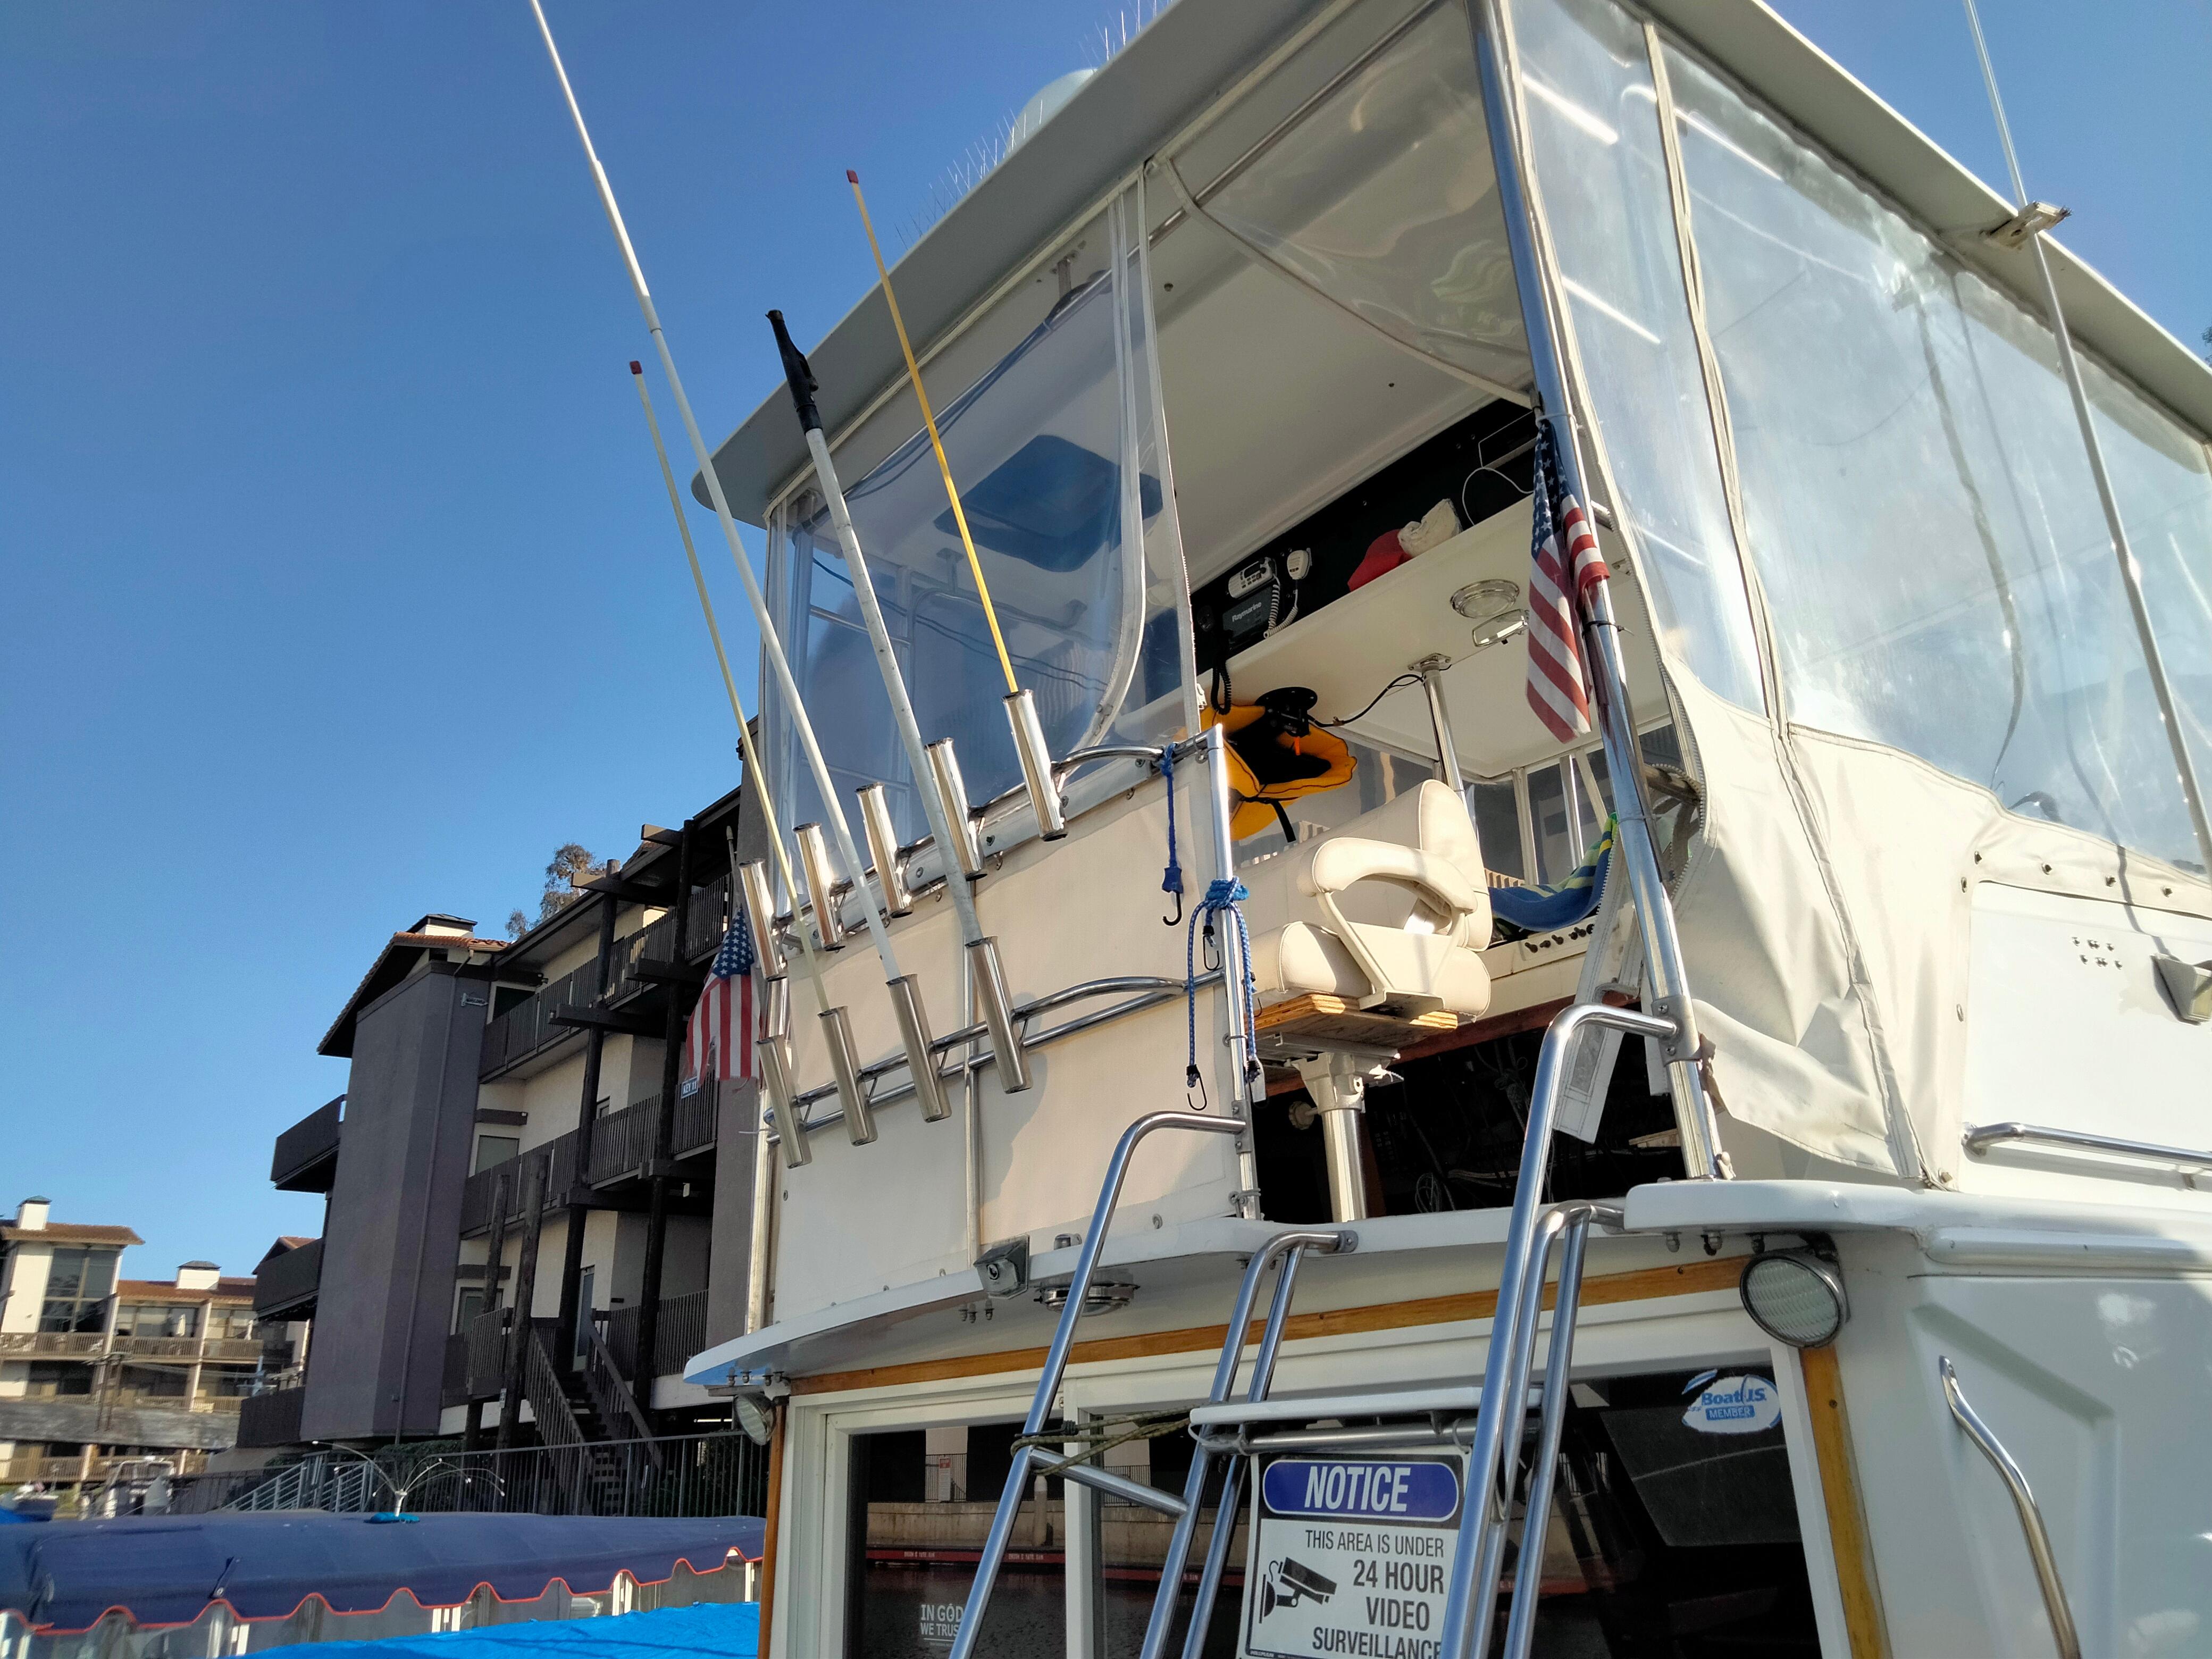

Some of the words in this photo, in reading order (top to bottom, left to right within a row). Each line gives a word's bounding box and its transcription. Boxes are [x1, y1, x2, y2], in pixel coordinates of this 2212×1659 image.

[1232, 602, 1262, 622] Raymarine
[683, 1082, 691, 1094] KEY
[1710, 1407, 1751, 1419] MEMBER
[1304, 1465, 1411, 1512] NOTICE
[1305, 1529, 1334, 1550] THIS
[1337, 1531, 1373, 1553] AREA
[1378, 1534, 1390, 1554] IS
[1395, 1535, 1444, 1558] UNDER
[1353, 1559, 1378, 1588] 24
[1385, 1561, 1445, 1594] HOUR
[921, 1604, 934, 1621] IN
[937, 1604, 963, 1622] GOD
[1365, 1596, 1430, 1632] VIDEO
[920, 1622, 934, 1636] WE
[936, 1623, 959, 1637] TRUS
